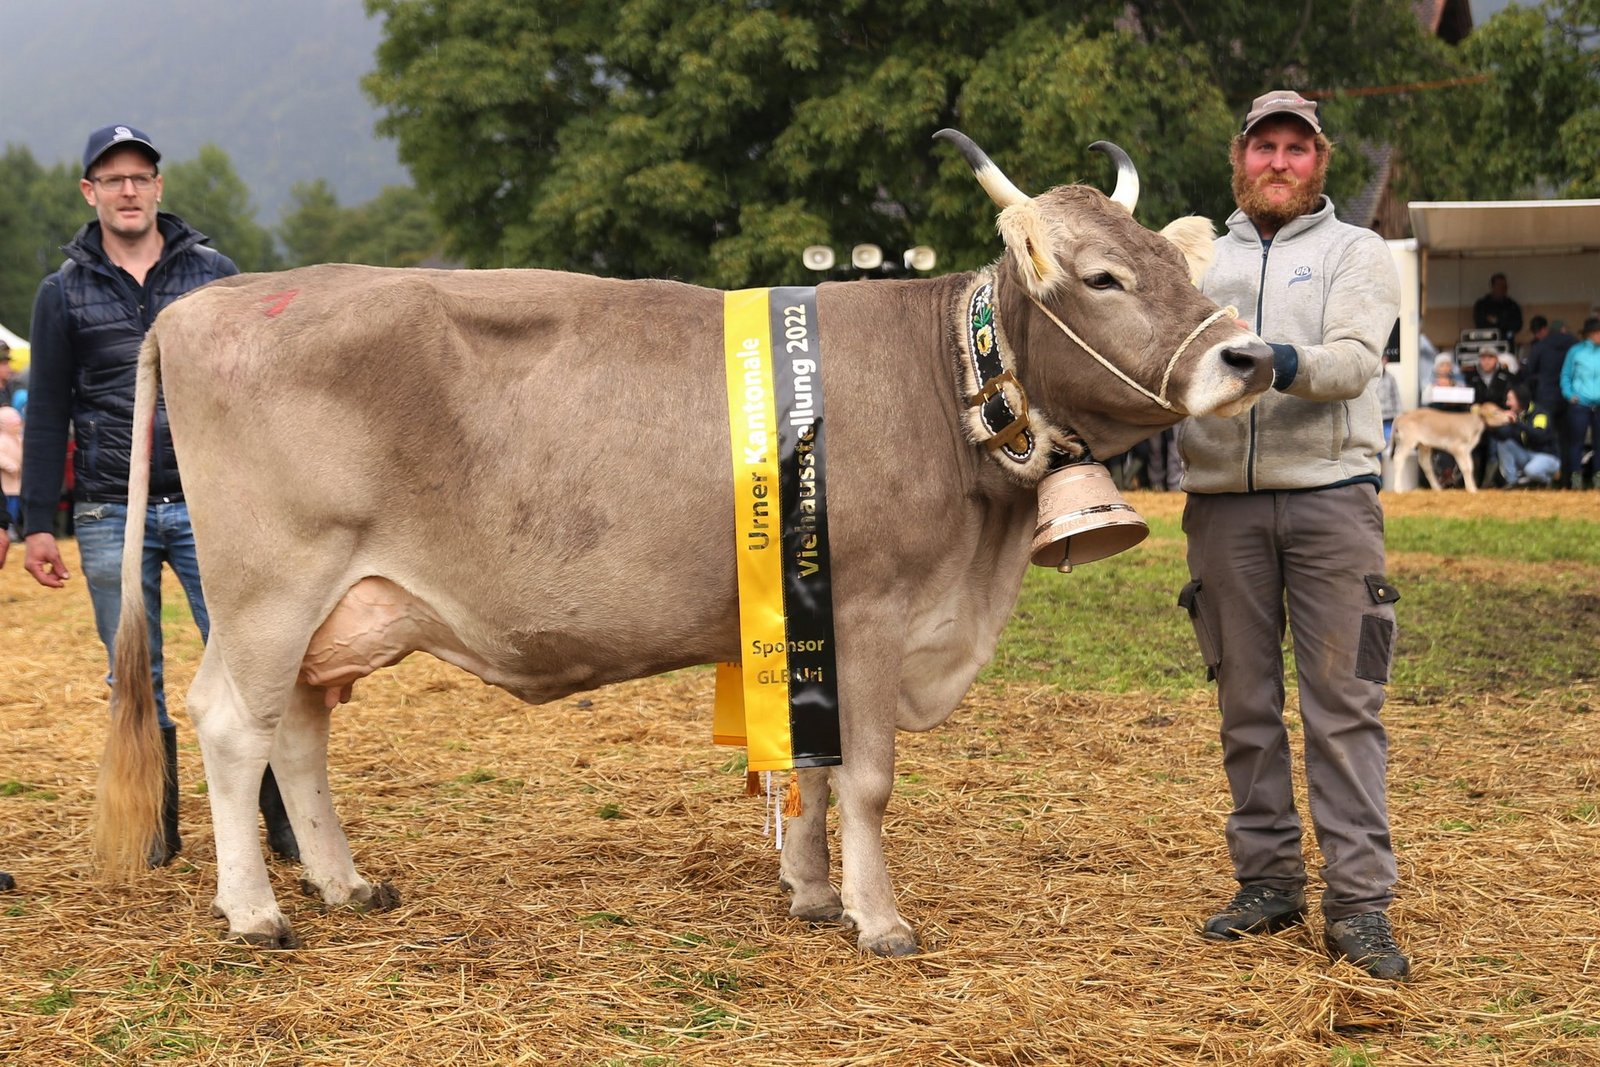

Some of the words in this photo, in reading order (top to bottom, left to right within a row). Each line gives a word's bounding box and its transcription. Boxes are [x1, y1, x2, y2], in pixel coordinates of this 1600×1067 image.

[783, 303, 809, 354] 2022
[737, 337, 768, 464] Kantonale
[789, 358, 820, 579] Viehausstellung
[748, 472, 770, 551] Urner
[752, 638, 825, 658] Sponsor
[795, 666, 824, 684] Uri
